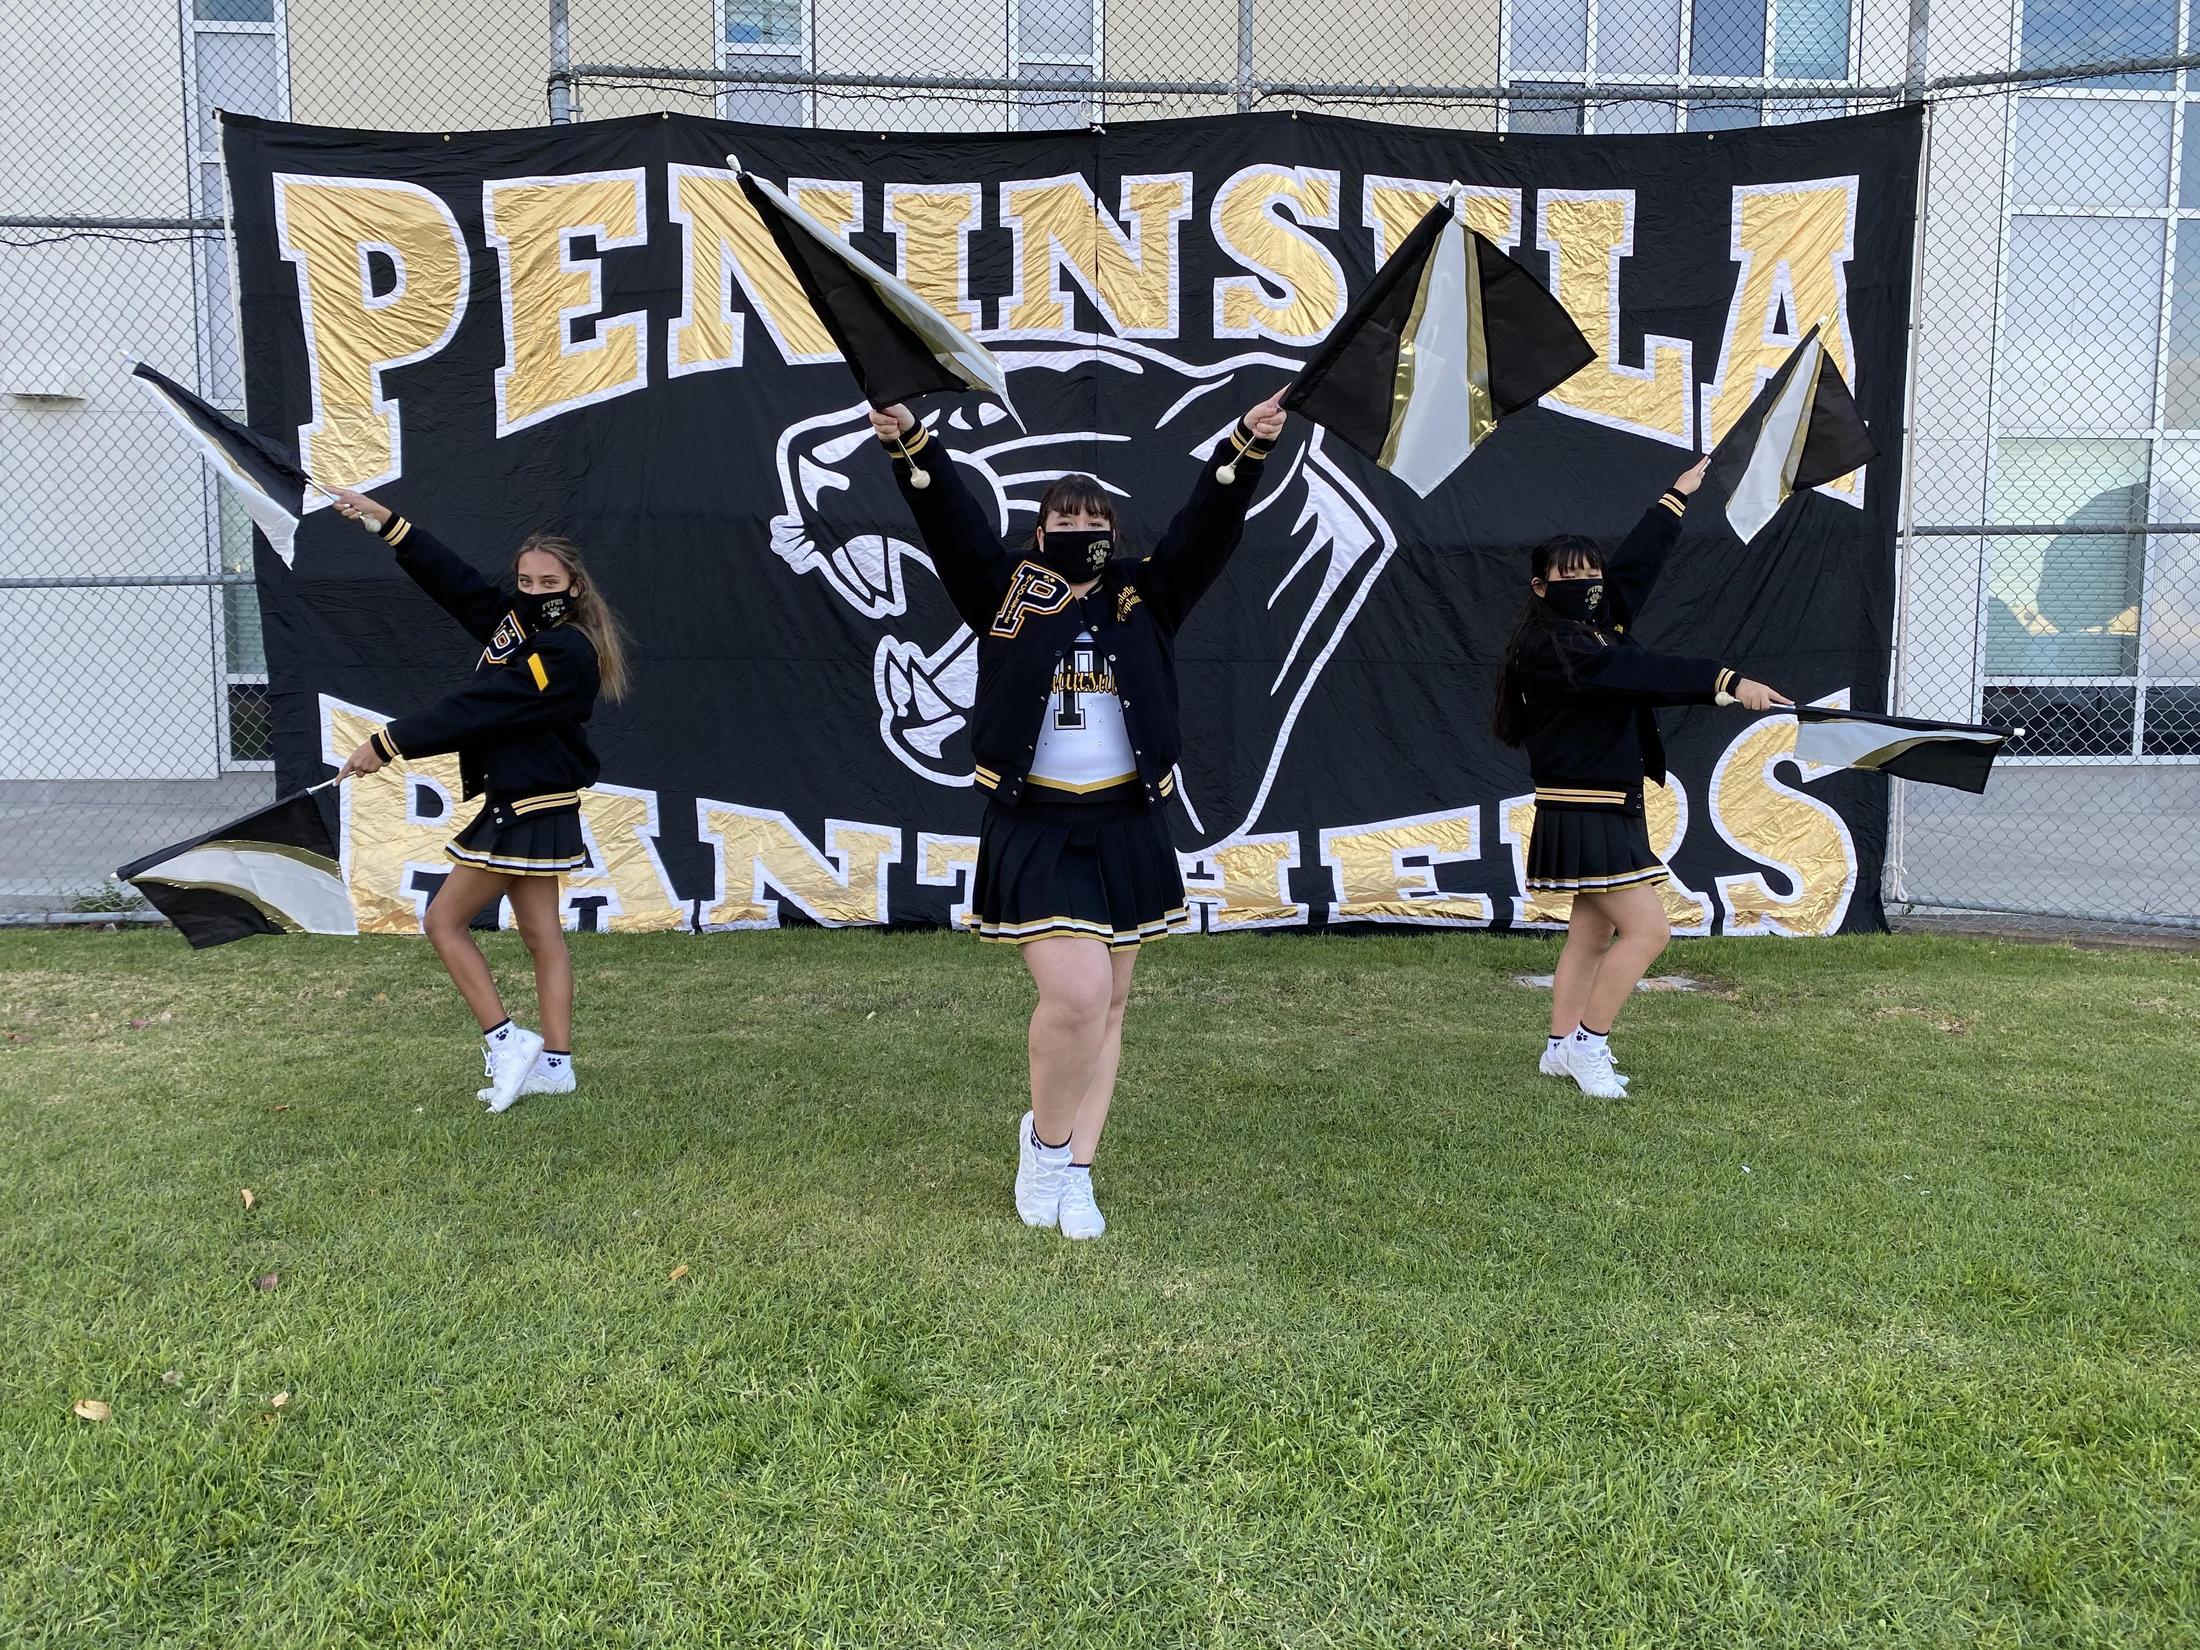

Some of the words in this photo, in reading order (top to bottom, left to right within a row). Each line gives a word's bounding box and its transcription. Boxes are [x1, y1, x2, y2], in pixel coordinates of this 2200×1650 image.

[990, 560, 1074, 639] P
[1003, 573, 1035, 624] NICOLETTE
[318, 687, 1858, 938] PANHES
